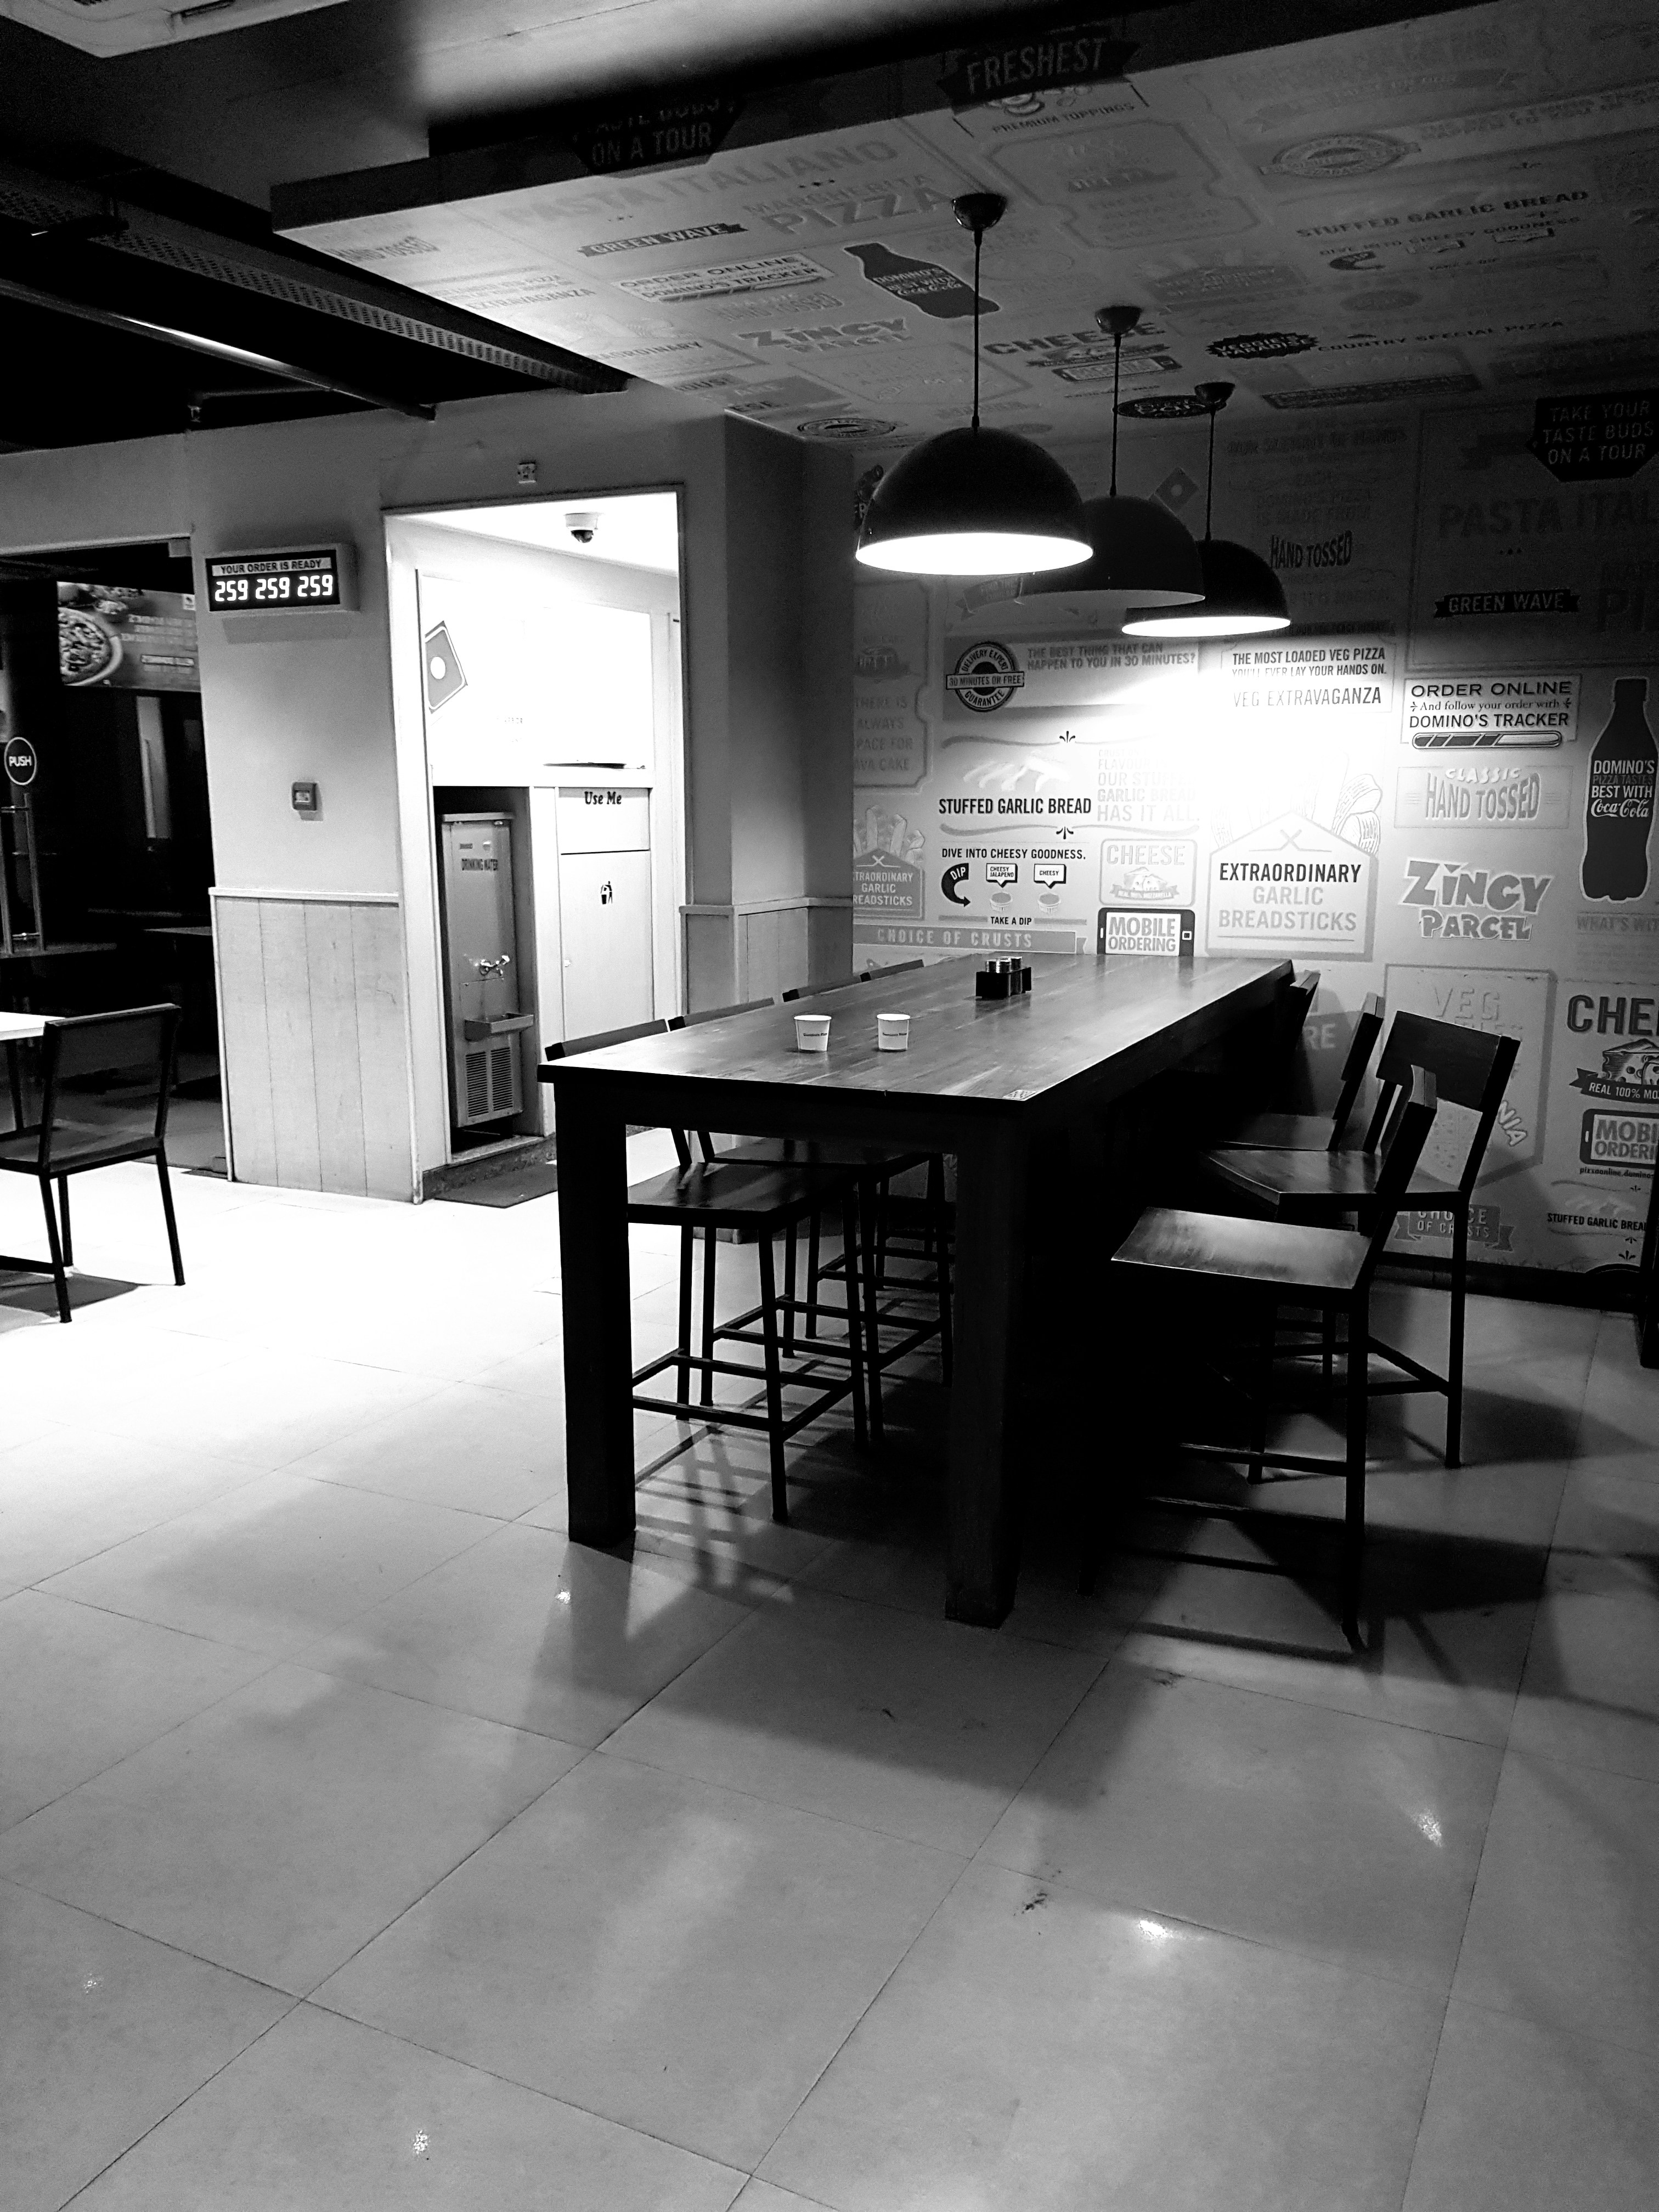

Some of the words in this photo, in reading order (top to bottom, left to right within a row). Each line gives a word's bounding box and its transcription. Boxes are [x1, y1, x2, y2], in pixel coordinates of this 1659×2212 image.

[966, 36, 1107, 94] FRESHEST
[992, 115, 1060, 134] PREMIUM
[1063, 102, 1135, 121] TOPPINGS
[591, 140, 620, 166] ON
[630, 136, 644, 160] A
[653, 121, 712, 155] TOUR
[761, 187, 952, 234] PIZZA
[1296, 217, 1399, 237] STUFFED
[1407, 204, 1496, 222] GARLIC
[1503, 191, 1589, 209] BREAD
[591, 233, 661, 255] GREEN
[663, 223, 726, 243] WAVE
[620, 272, 701, 287] ORDER
[707, 256, 799, 275] ONLINE
[733, 268, 819, 284] TRACKER
[465, 288, 596, 310] EXTRAVAGANZA
[733, 317, 905, 347] ZINGY
[1318, 337, 1406, 352] COUNTRY
[1416, 329, 1493, 341] SPECIAL
[1504, 321, 1563, 332] PIZZA
[1221, 338, 1310, 356] PARADISE
[1550, 405, 1591, 422] TAKE
[1601, 400, 1650, 419] YOUR
[1543, 425, 1596, 444] TASTE
[1605, 421, 1655, 439] BUDS
[1548, 447, 1572, 465] ON
[1579, 447, 1590, 462] A
[1599, 443, 1646, 461] TOUR
[1438, 496, 1564, 538] PASTA
[1271, 534, 1304, 569] HAND
[1306, 530, 1353, 568] TOSSED
[221, 564, 245, 574] YOUR
[247, 562, 277, 572] ORDER
[280, 561, 289, 570] IS
[291, 559, 322, 569] READY
[215, 579, 249, 602] 259
[255, 577, 290, 600] 259
[297, 574, 334, 597] 259
[1448, 594, 1505, 613] GREEN
[1512, 591, 1565, 610] WAVE
[1028, 647, 1046, 659] THE
[1049, 646, 1075, 658] BEST
[1077, 644, 1109, 656] THING
[1112, 643, 1139, 655] THAT
[1142, 642, 1163, 654] CAN
[1233, 652, 1252, 665] THE
[1254, 651, 1284, 664] MOST
[1285, 650, 1326, 663] LOADED
[1329, 648, 1350, 662] VEG
[1353, 647, 1386, 661] PIZZA
[1027, 658, 1067, 670] HAPPEN
[1071, 658, 1083, 668] TO
[1086, 657, 1107, 668] YOU
[1110, 657, 1122, 668] IN
[1124, 656, 1139, 667] 30
[1142, 653, 1196, 666] MINUTES?
[1265, 667, 1288, 678] EVER
[1290, 666, 1306, 677] LAY
[1308, 665, 1334, 676] YOUR
[1336, 664, 1368, 675] HANDS
[1370, 663, 1387, 675] ON.
[949, 677, 958, 687] 30
[960, 676, 990, 686] MINUTES
[991, 675, 1001, 685] OR
[1003, 674, 1022, 685] FREE
[1410, 682, 1483, 698] ORDER
[1490, 680, 1573, 696] ONLINE
[964, 690, 1005, 707] GUARANTEE
[1233, 691, 1260, 708] VEG
[1267, 686, 1382, 707] EXTRAVAGANZA
[1420, 701, 1442, 712] And
[1444, 699, 1477, 711] follow
[1478, 702, 1502, 714] your
[1504, 699, 1533, 709] order
[1536, 698, 1560, 709] with
[857, 718, 904, 731] ALWAYS
[1409, 714, 1489, 729] DOMINO'S
[1494, 712, 1569, 727] TRACKER
[891, 737, 913, 751] FOR
[8, 754, 33, 768] PUSH
[879, 758, 910, 771] CAKE
[1098, 758, 1150, 770] FLAVOUR
[1593, 760, 1655, 775] DOMINO'S
[1098, 771, 1127, 786] OUR
[1444, 768, 1521, 785] CLASSIC
[1593, 775, 1619, 785] PIZZA
[1622, 775, 1654, 785] TASTES
[584, 791, 603, 805] Use
[606, 791, 623, 805] Me
[1097, 788, 1146, 802] GARLIC
[1150, 788, 1196, 802] BREAD
[1425, 772, 1471, 820] HAND
[1475, 772, 1541, 820] TOSSED
[1592, 785, 1620, 798] BEST
[1622, 785, 1653, 798] WITH
[939, 797, 994, 815] STUFFED
[997, 797, 1044, 815] GARLIC
[1048, 797, 1092, 815] BREAD
[1097, 804, 1132, 822] HAS
[1140, 804, 1157, 822] IT
[1163, 804, 1200, 822] ALL.
[941, 848, 962, 858] DIVE
[966, 848, 988, 859] INTO
[990, 848, 1028, 860] CHEESY
[1031, 849, 1087, 860] GOODNESS.
[1106, 844, 1186, 867] CHEESE
[950, 867, 967, 880] DIP
[1219, 862, 1362, 883] EXTRAORDINARY
[861, 882, 896, 894] GARLIC
[1401, 859, 1553, 913] ZINGY
[1252, 885, 1324, 906] GARLIC
[990, 916, 1009, 926] TAKE
[1011, 917, 1017, 925] A
[1019, 916, 1032, 926] DIP
[1108, 915, 1177, 938] MOBILE
[1218, 909, 1357, 932] BREADSTICKS
[1420, 909, 1532, 940] PARCEL
[1577, 915, 1629, 932] WHAT'S
[878, 928, 934, 944] CHOICE
[943, 930, 961, 946] OF
[969, 932, 1033, 949] CRUSTS
[1108, 935, 1177, 953] ORDERING
[1432, 986, 1501, 1021] VEG
[1567, 994, 1659, 1036] CHE
[1588, 1081, 1611, 1096] REAL
[1615, 1086, 1641, 1099] 100%
[1595, 1119, 1658, 1144] MOBI
[1594, 1139, 1657, 1160] ORDERI
[1417, 1220, 1433, 1232] OF
[1547, 1212, 1585, 1226] STUFFED
[1586, 1216, 1619, 1229] GARLIC
[1620, 1220, 1647, 1232] BREA
